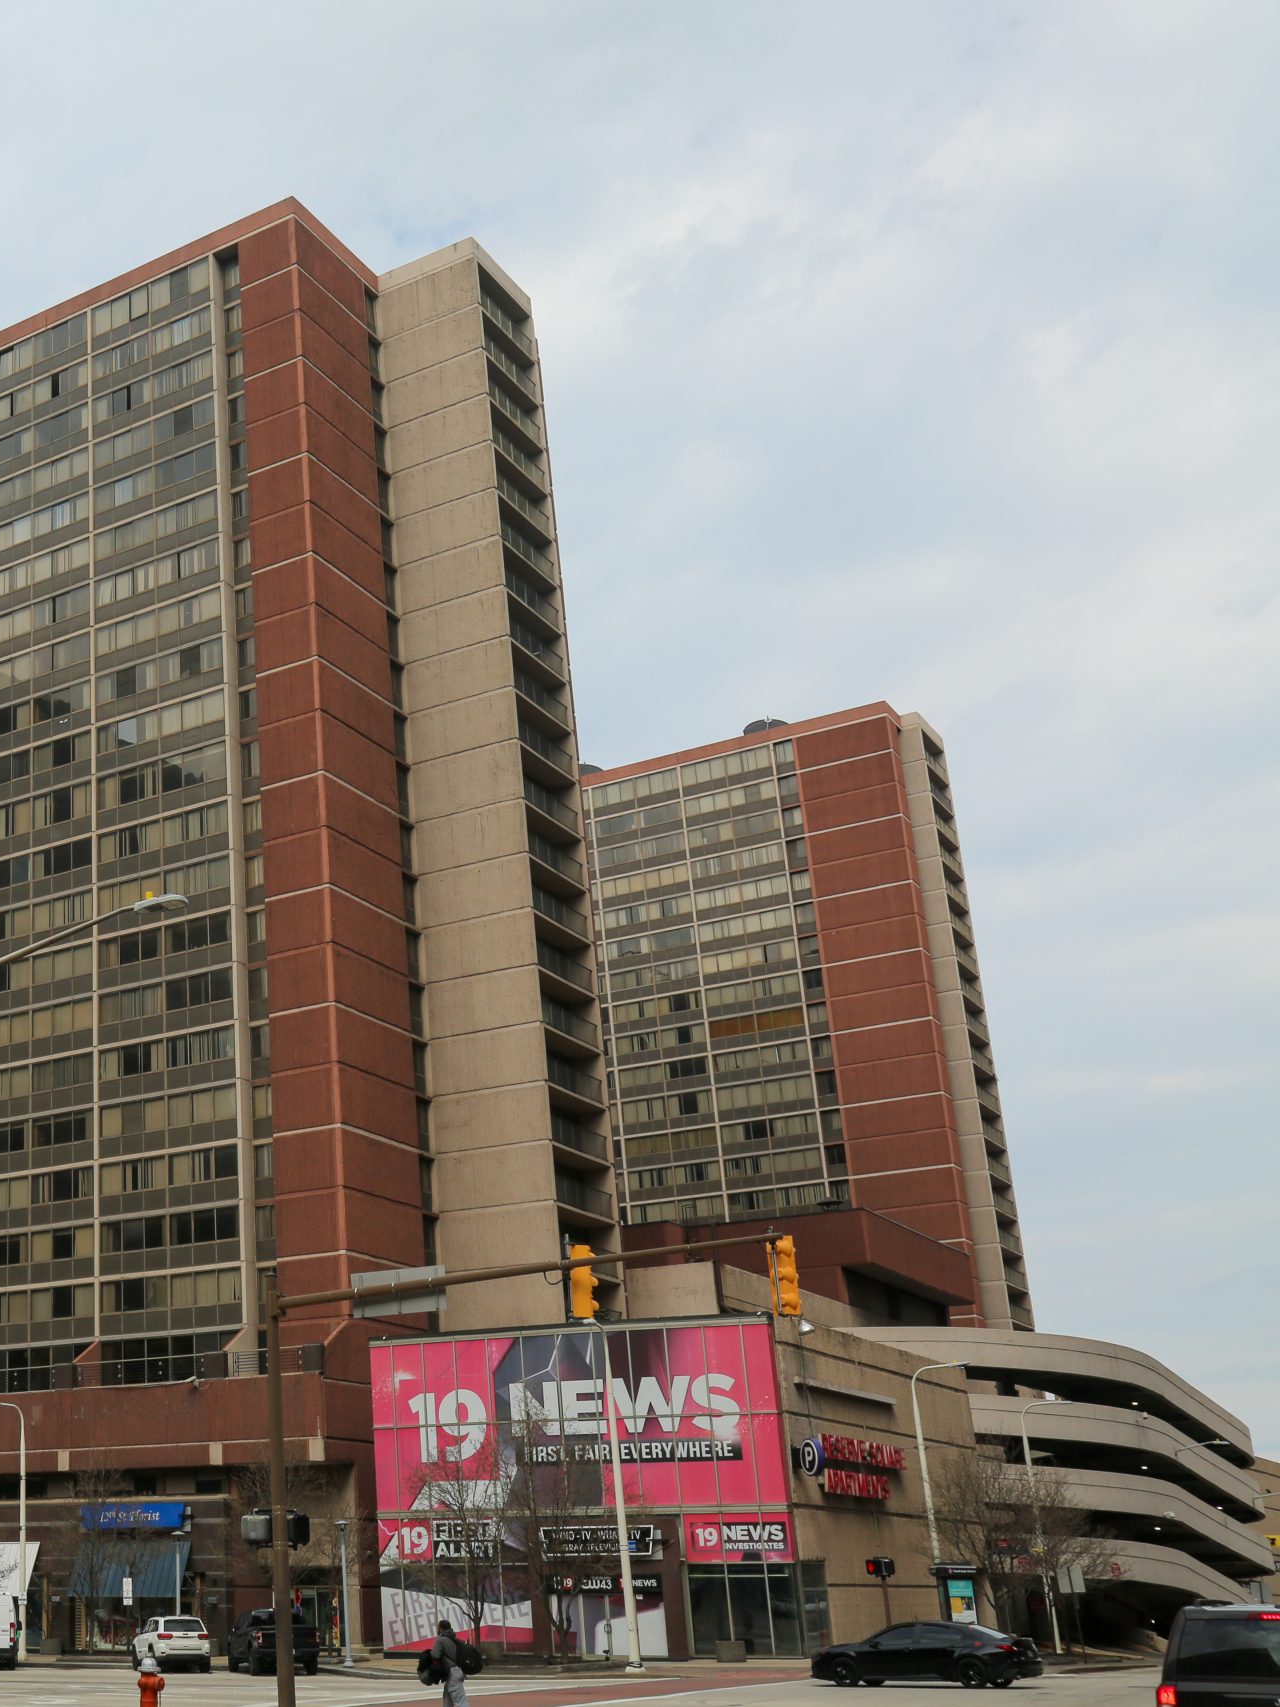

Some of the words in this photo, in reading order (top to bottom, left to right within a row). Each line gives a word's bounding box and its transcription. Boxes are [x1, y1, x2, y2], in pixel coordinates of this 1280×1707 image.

[408, 1389, 487, 1463] 19
[508, 1373, 741, 1437] NEWS
[620, 1440, 734, 1460] EVERYWHERE
[824, 1469, 892, 1500] APARTMENTS
[129, 1509, 161, 1521] Florist
[400, 1526, 429, 1555] 19
[695, 1527, 718, 1547] 19
[722, 1524, 784, 1541] NEWS
[562, 1543, 583, 1552] GRAY
[632, 1579, 658, 1587] NEWS
